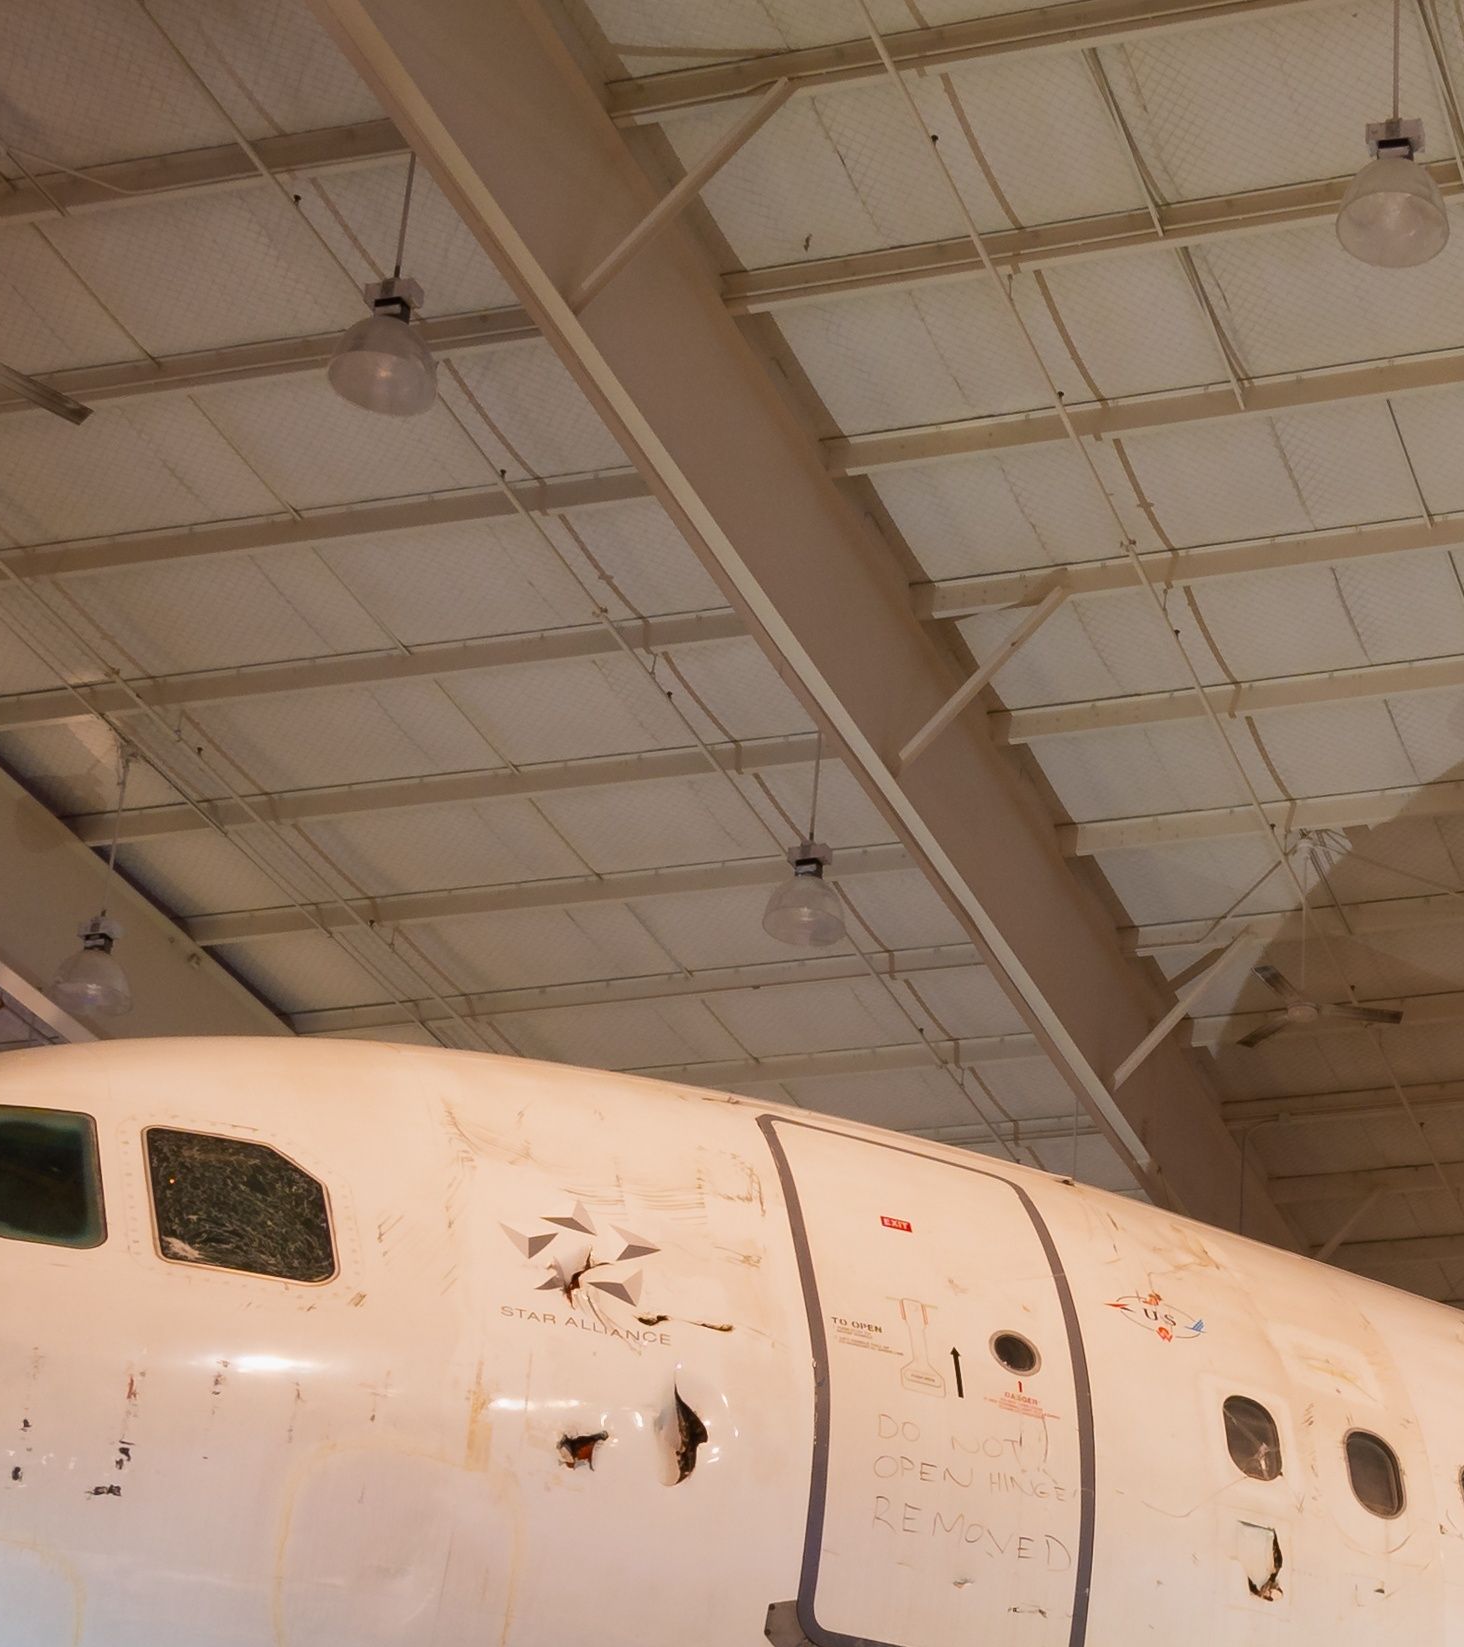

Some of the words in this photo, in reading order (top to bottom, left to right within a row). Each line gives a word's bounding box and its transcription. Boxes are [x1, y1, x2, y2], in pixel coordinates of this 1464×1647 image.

[882, 1217, 910, 1231] EXIT
[500, 1304, 558, 1327] STAR
[564, 1315, 673, 1348] ALLIANCE
[831, 1316, 848, 1327] TO
[851, 1318, 883, 1334] OPEN
[877, 1413, 920, 1442] DO
[950, 1436, 1023, 1467] NOT
[873, 1454, 974, 1488] OPEN
[872, 1495, 1072, 1572] REMOVED
